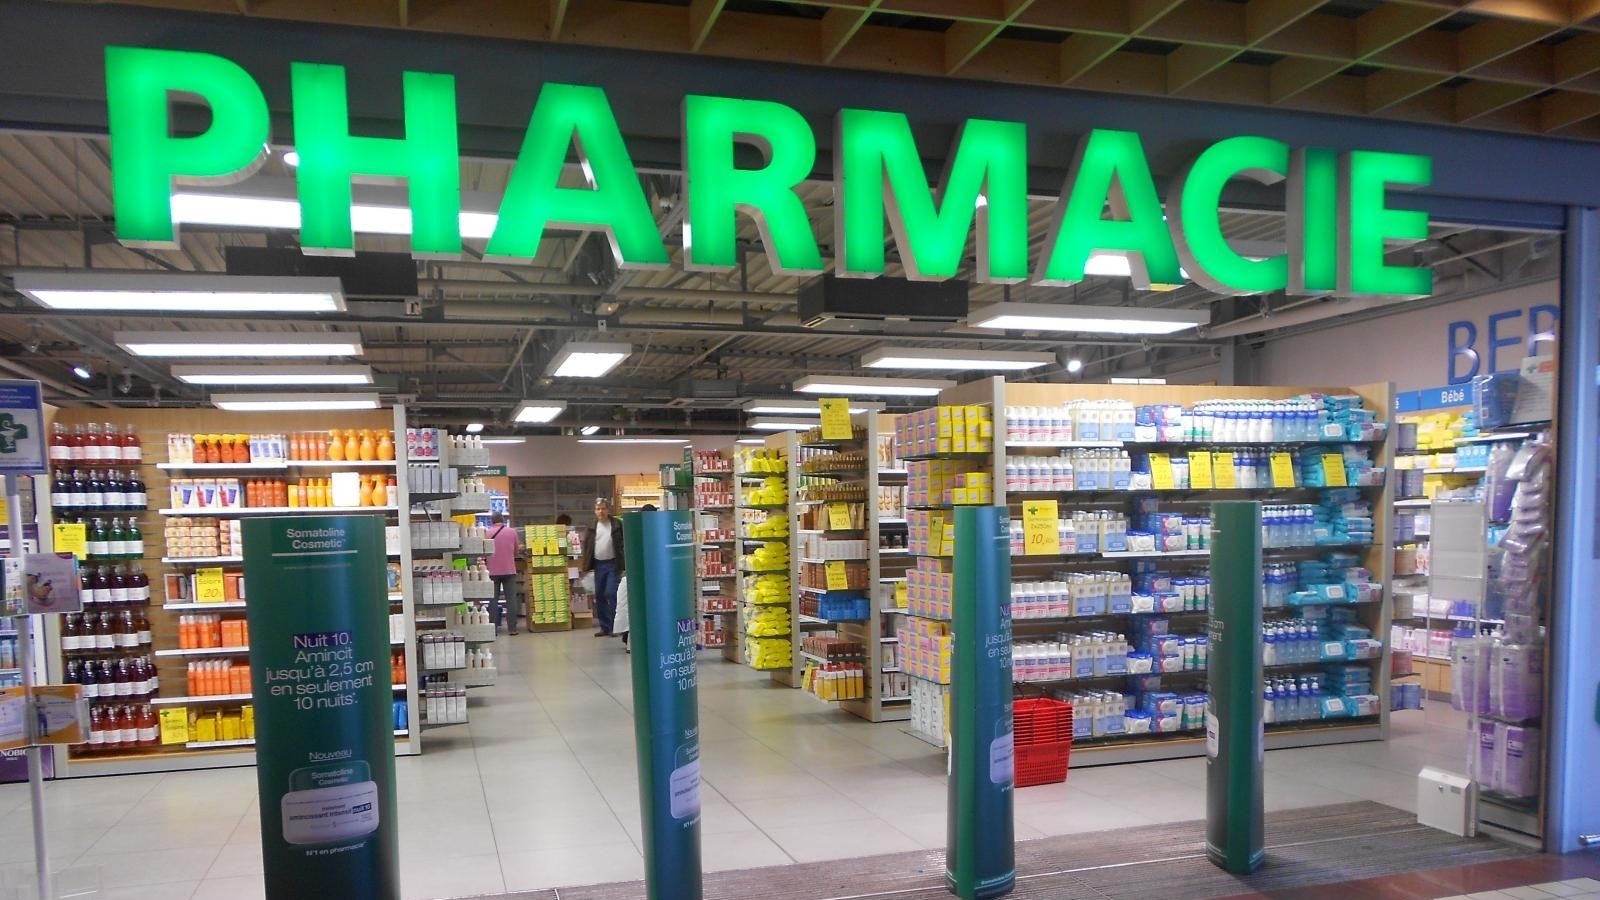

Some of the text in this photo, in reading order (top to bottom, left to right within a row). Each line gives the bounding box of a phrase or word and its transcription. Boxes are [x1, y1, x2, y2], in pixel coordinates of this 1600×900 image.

[104, 45, 1434, 297] PHARMACIE
[1441, 388, 1465, 404] Bébé
[286, 528, 345, 538] Somatoline
[291, 539, 343, 549] Cosmetic
[293, 631, 353, 648] Nuit 10.
[295, 647, 353, 663] Amincit
[265, 660, 374, 684] jusqu'à 2,5 cm
[663, 668, 678, 680] en
[270, 675, 373, 696] en seulement
[677, 678, 688, 691] 10
[293, 696, 313, 710] 10
[309, 749, 352, 759] Nouveau
